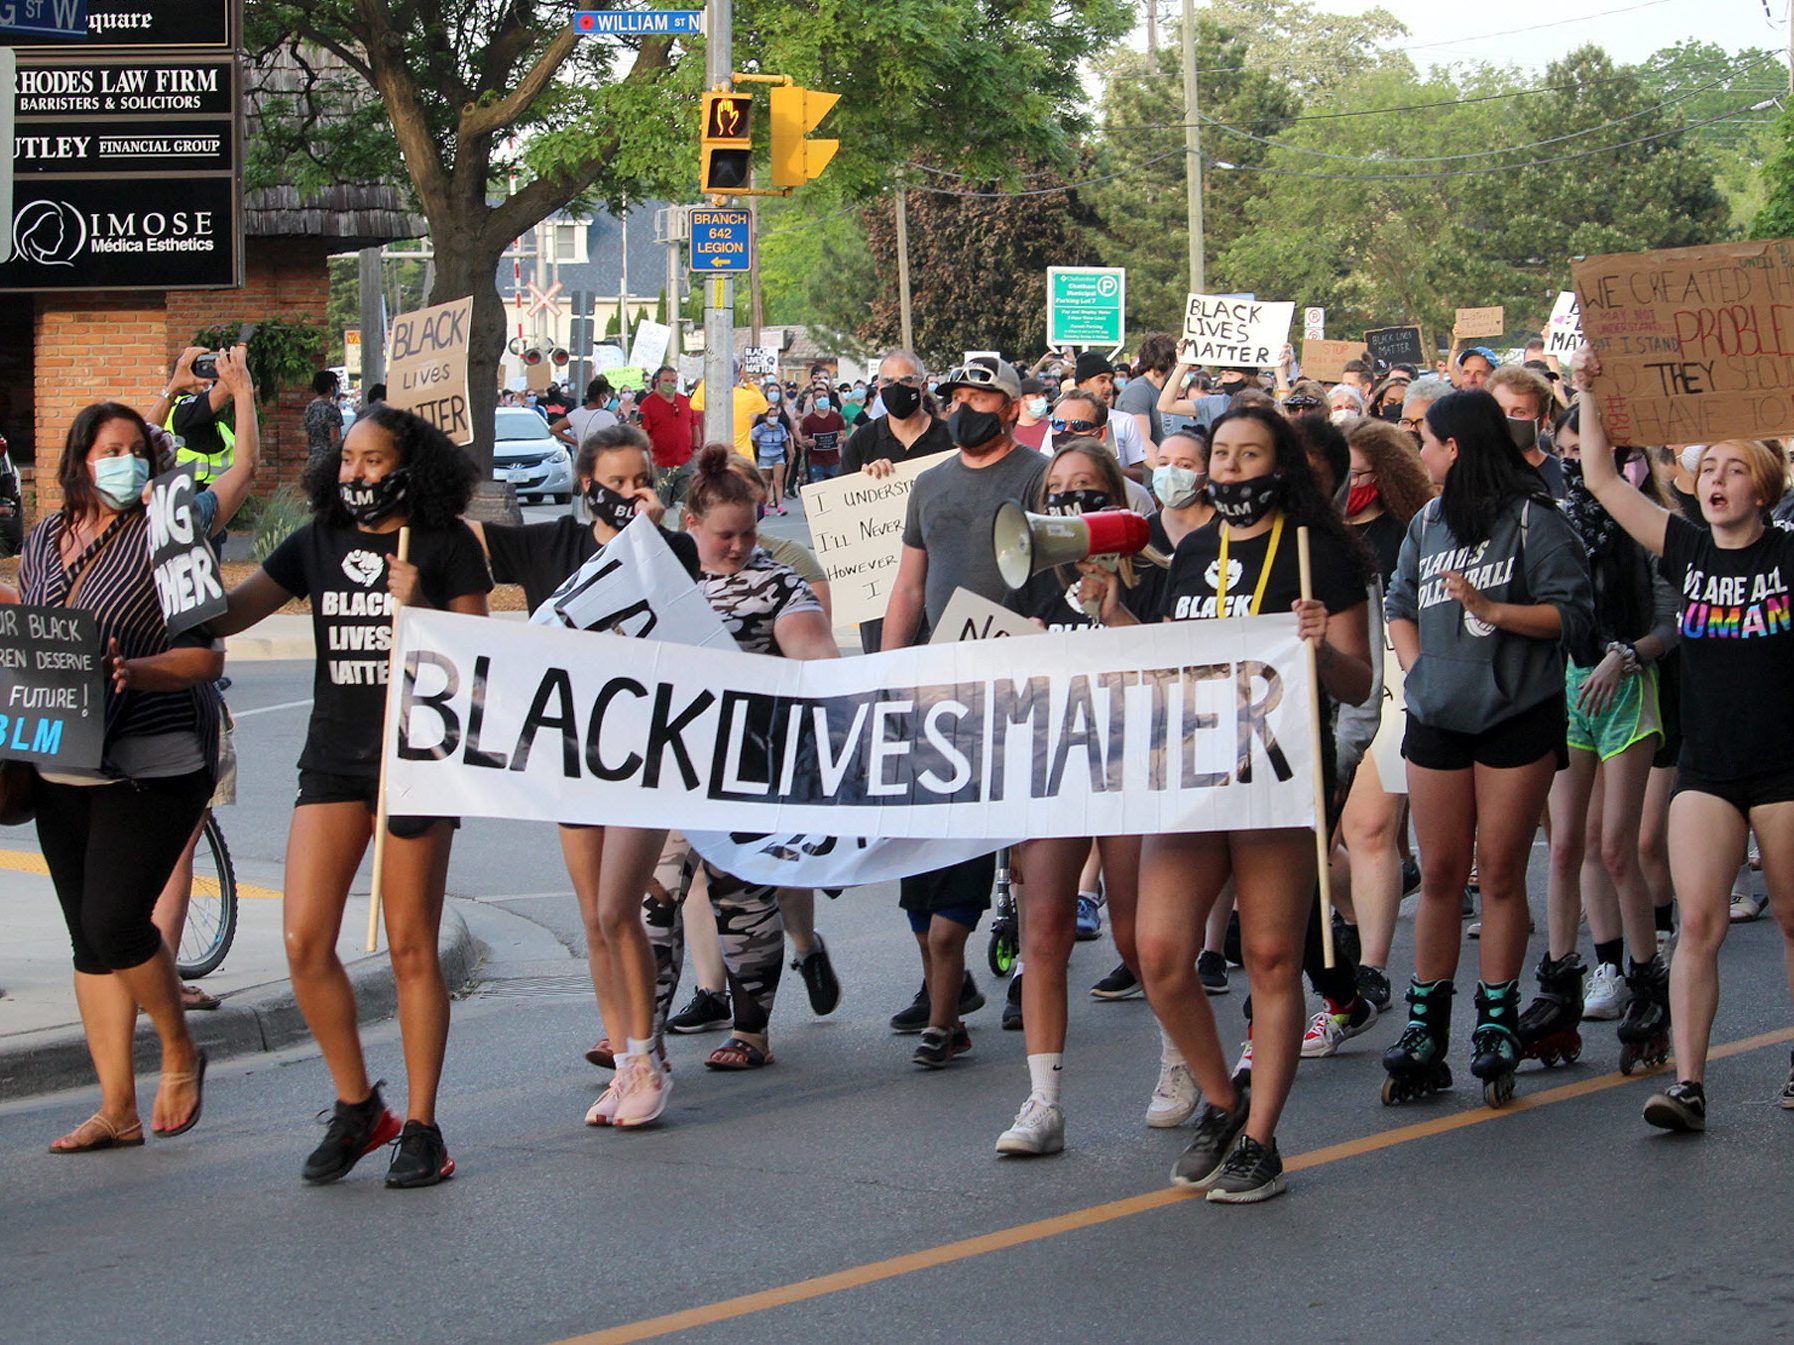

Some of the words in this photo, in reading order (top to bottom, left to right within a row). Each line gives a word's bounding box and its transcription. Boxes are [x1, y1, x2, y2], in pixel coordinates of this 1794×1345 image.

[86, 12, 153, 34] quare
[597, 15, 668, 31] WILLIAM
[674, 18, 686, 27] ST
[689, 14, 700, 31] N
[100, 69, 149, 93] LAW
[155, 69, 218, 92] FIRM
[20, 97, 100, 110] BARRISTERS
[104, 97, 115, 109] &
[120, 95, 201, 109] SOLICITORS
[99, 141, 171, 153] FINANCIAL
[173, 140, 220, 152] GROUP
[693, 213, 747, 225] BRANCH
[91, 238, 143, 253] Médica
[147, 236, 214, 252] Esthetics
[708, 227, 733, 239] 642
[697, 242, 743, 253] LEGION
[1577, 275, 1623, 309] WE
[1629, 266, 1752, 304] CREATED
[1189, 298, 1263, 324] BLACK
[392, 308, 466, 361] BLACK
[1186, 318, 1250, 344] LIVES
[1182, 338, 1270, 364] MATTER
[1643, 360, 1716, 397] THEY
[404, 395, 468, 435] TTER
[614, 504, 634, 518] BL
[810, 491, 833, 517] I
[859, 517, 906, 541] NEVER
[826, 554, 898, 582] HOWEVER
[862, 580, 881, 600] I
[1702, 575, 1748, 606] ARE
[28, 613, 82, 642] BLACK
[328, 625, 392, 651] LIVES
[35, 650, 94, 671] DESERVE
[328, 659, 389, 685] ATTE
[397, 650, 716, 792] BLACK
[720, 698, 972, 798] LIVES
[988, 659, 1294, 802] MATTER
